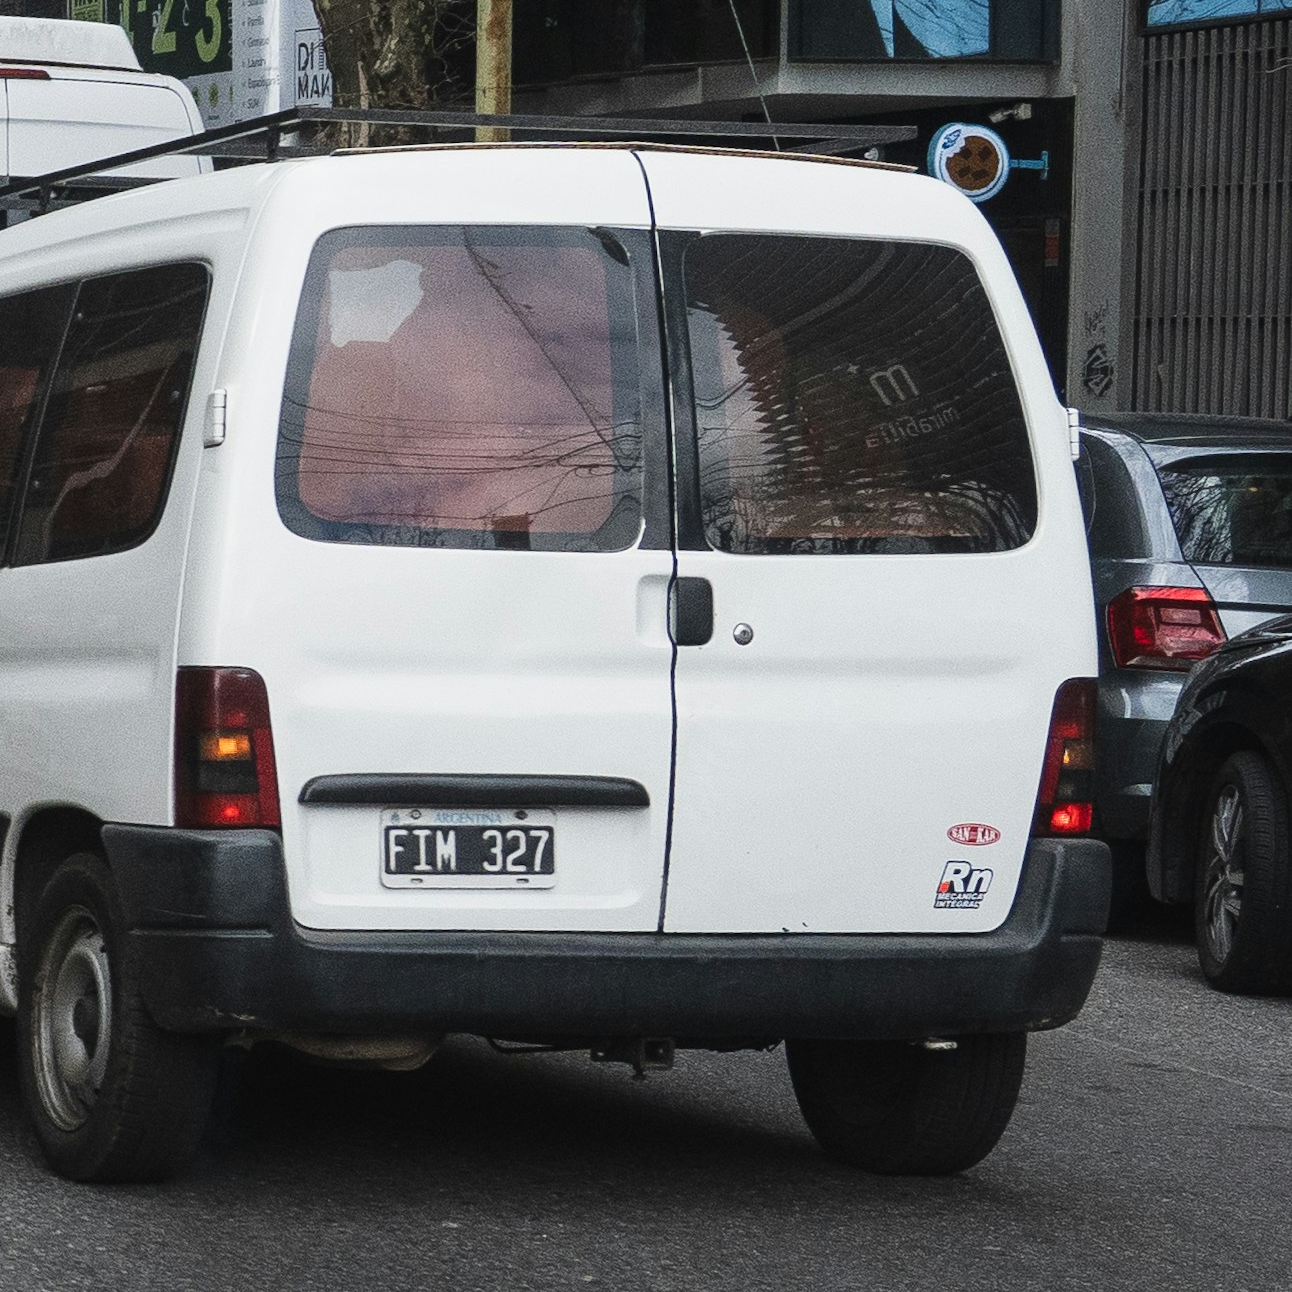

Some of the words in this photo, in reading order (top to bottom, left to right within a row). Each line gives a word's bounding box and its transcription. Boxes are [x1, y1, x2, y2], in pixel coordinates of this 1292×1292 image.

[435, 811, 504, 825] ARGENTINA
[388, 829, 457, 872] FIM
[482, 829, 550, 872] 327
